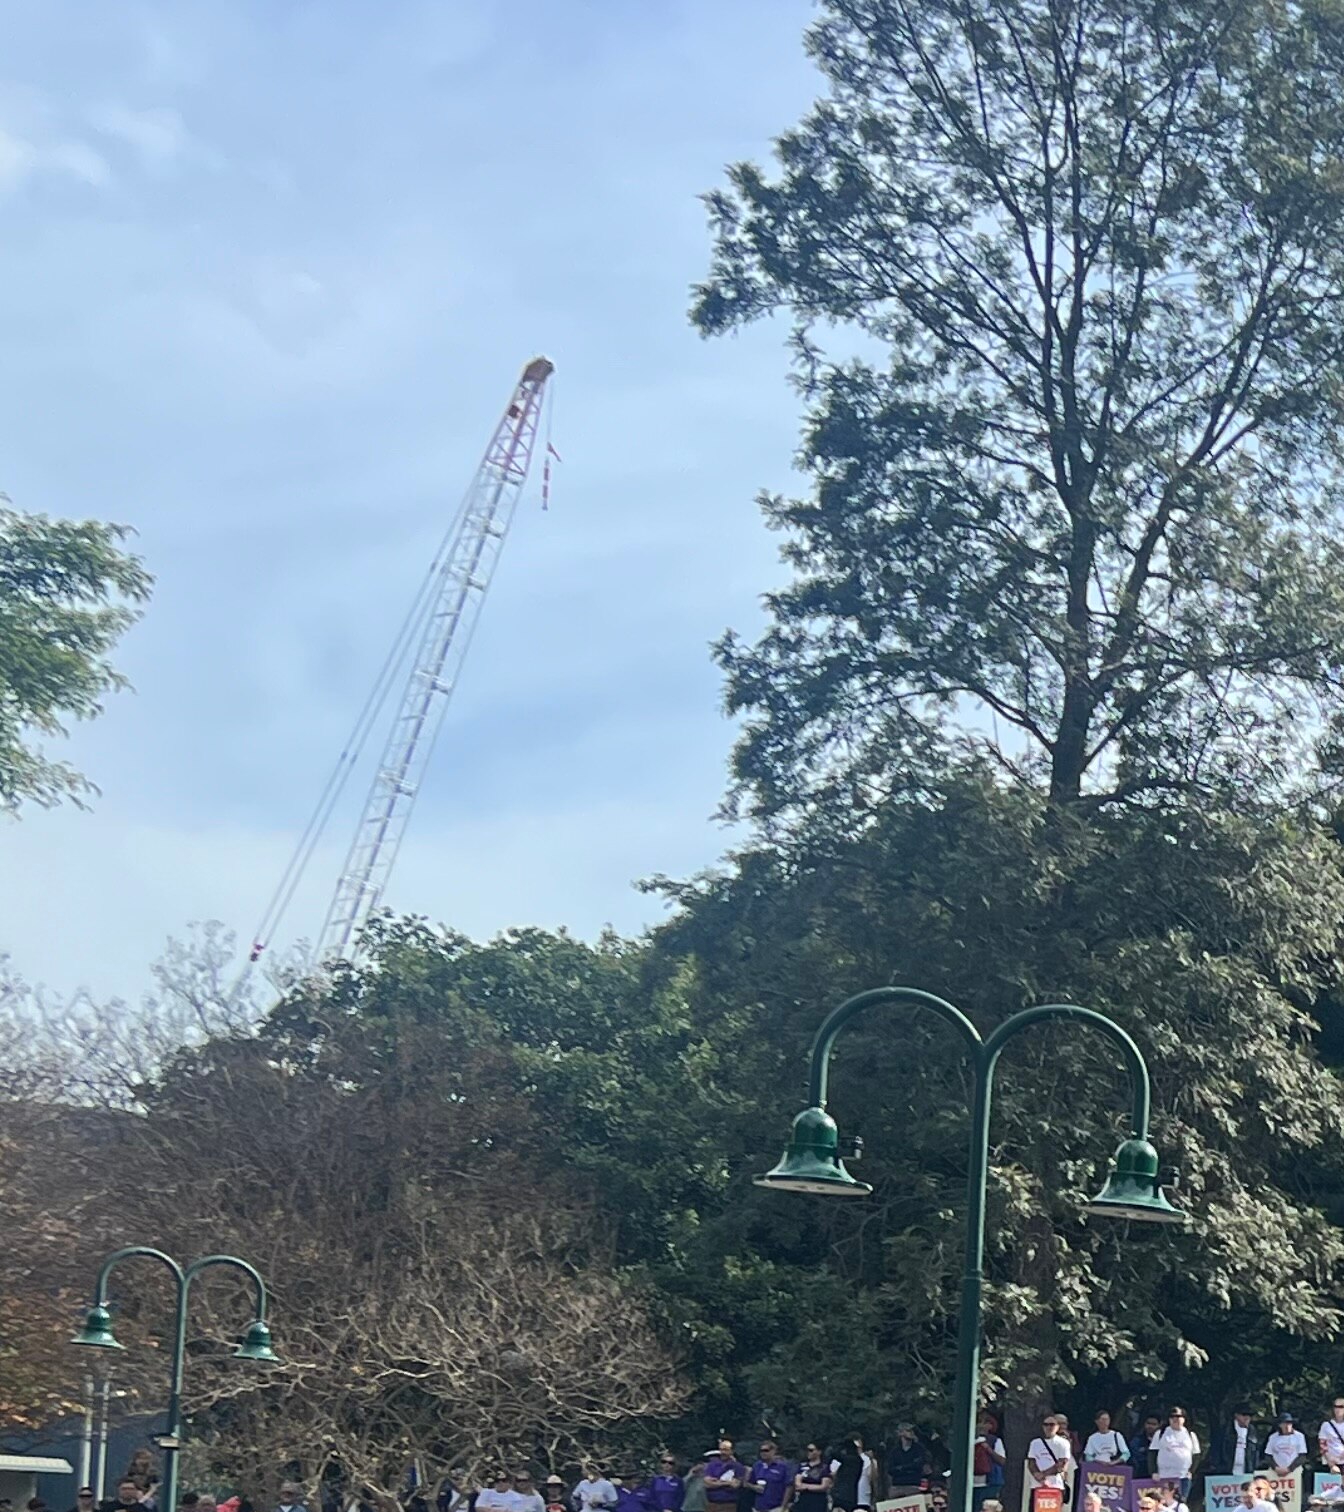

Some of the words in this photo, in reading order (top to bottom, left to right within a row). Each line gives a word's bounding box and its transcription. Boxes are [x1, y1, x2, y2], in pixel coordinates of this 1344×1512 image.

[1087, 1472, 1125, 1486] VOTE
[1270, 1478, 1294, 1489] OTE
[1212, 1484, 1241, 1495] VOT
